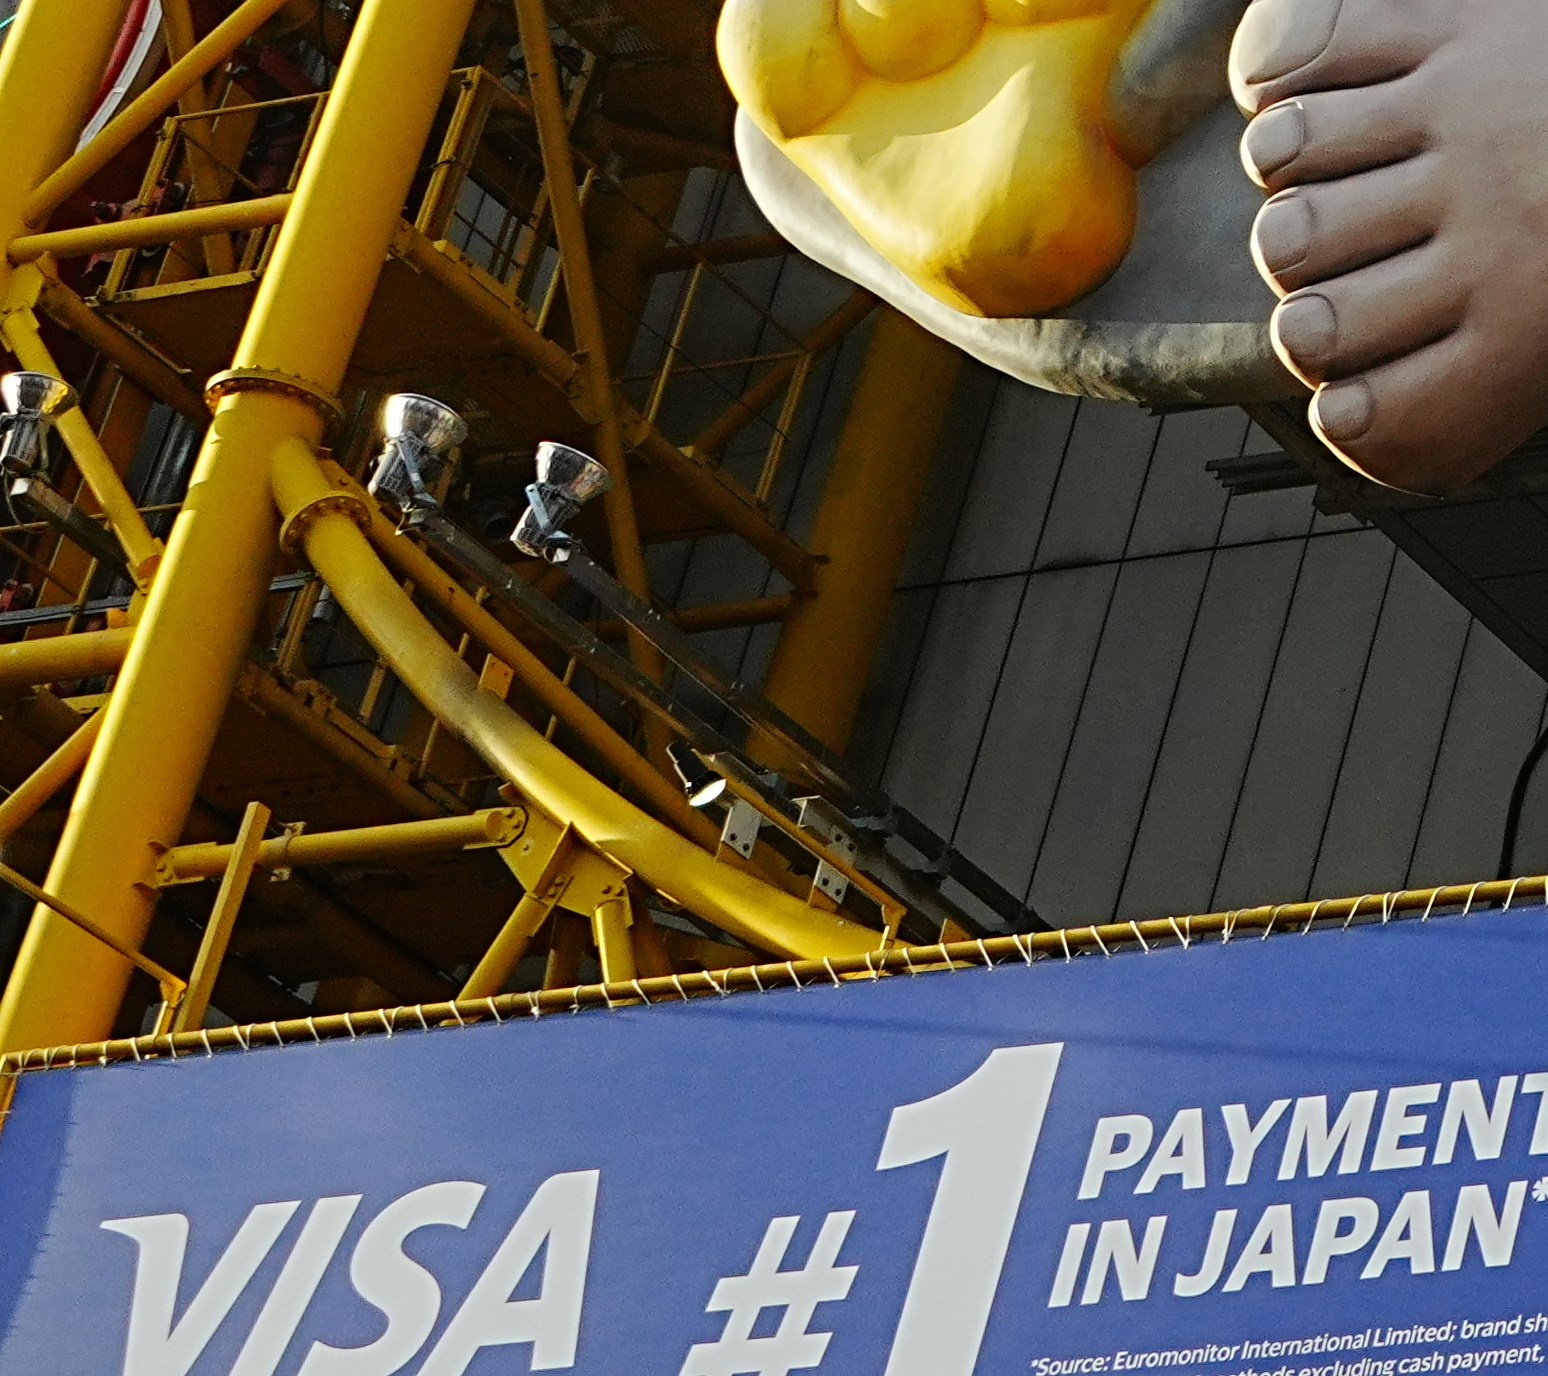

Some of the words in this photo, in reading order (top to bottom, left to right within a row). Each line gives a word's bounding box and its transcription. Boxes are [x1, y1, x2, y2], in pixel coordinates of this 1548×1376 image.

[676, 1041, 1065, 1376] #1
[100, 1169, 600, 1376] VISA
[1047, 1215, 1163, 1309] IN
[1112, 1342, 1242, 1371] Euromonitor
[1240, 1328, 1372, 1360] International
[1372, 1321, 1457, 1347] Limited;
[1460, 1314, 1522, 1338] brand
[1299, 1357, 1397, 1376] excluding
[1398, 1351, 1445, 1374] cash
[1445, 1343, 1547, 1375] payment,
